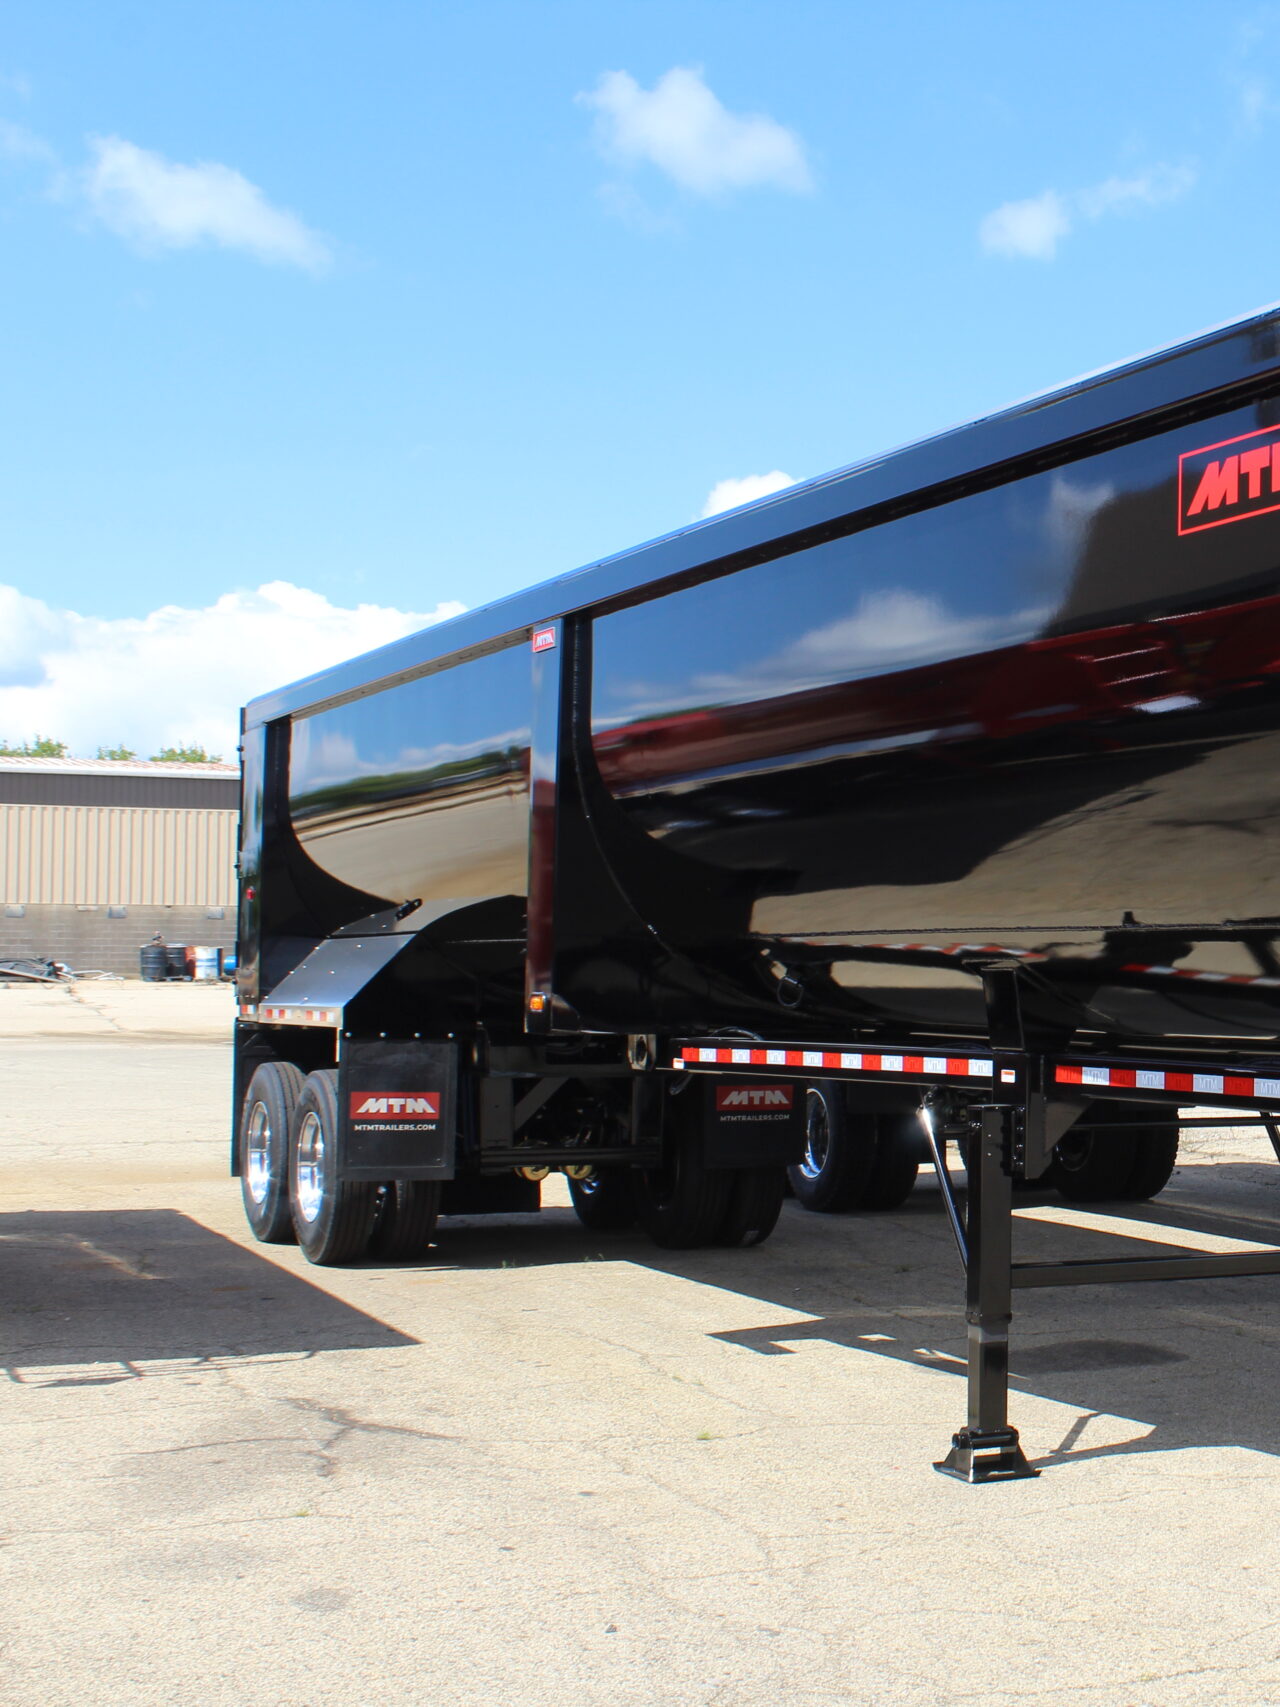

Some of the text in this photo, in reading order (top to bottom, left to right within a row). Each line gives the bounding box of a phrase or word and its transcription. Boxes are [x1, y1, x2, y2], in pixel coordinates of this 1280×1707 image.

[1261, 1082, 1280, 1095] MTM
[721, 1090, 789, 1105] MTM
[356, 1098, 436, 1113] MTM
[720, 1114, 790, 1122] MTMTRAILERS.COM
